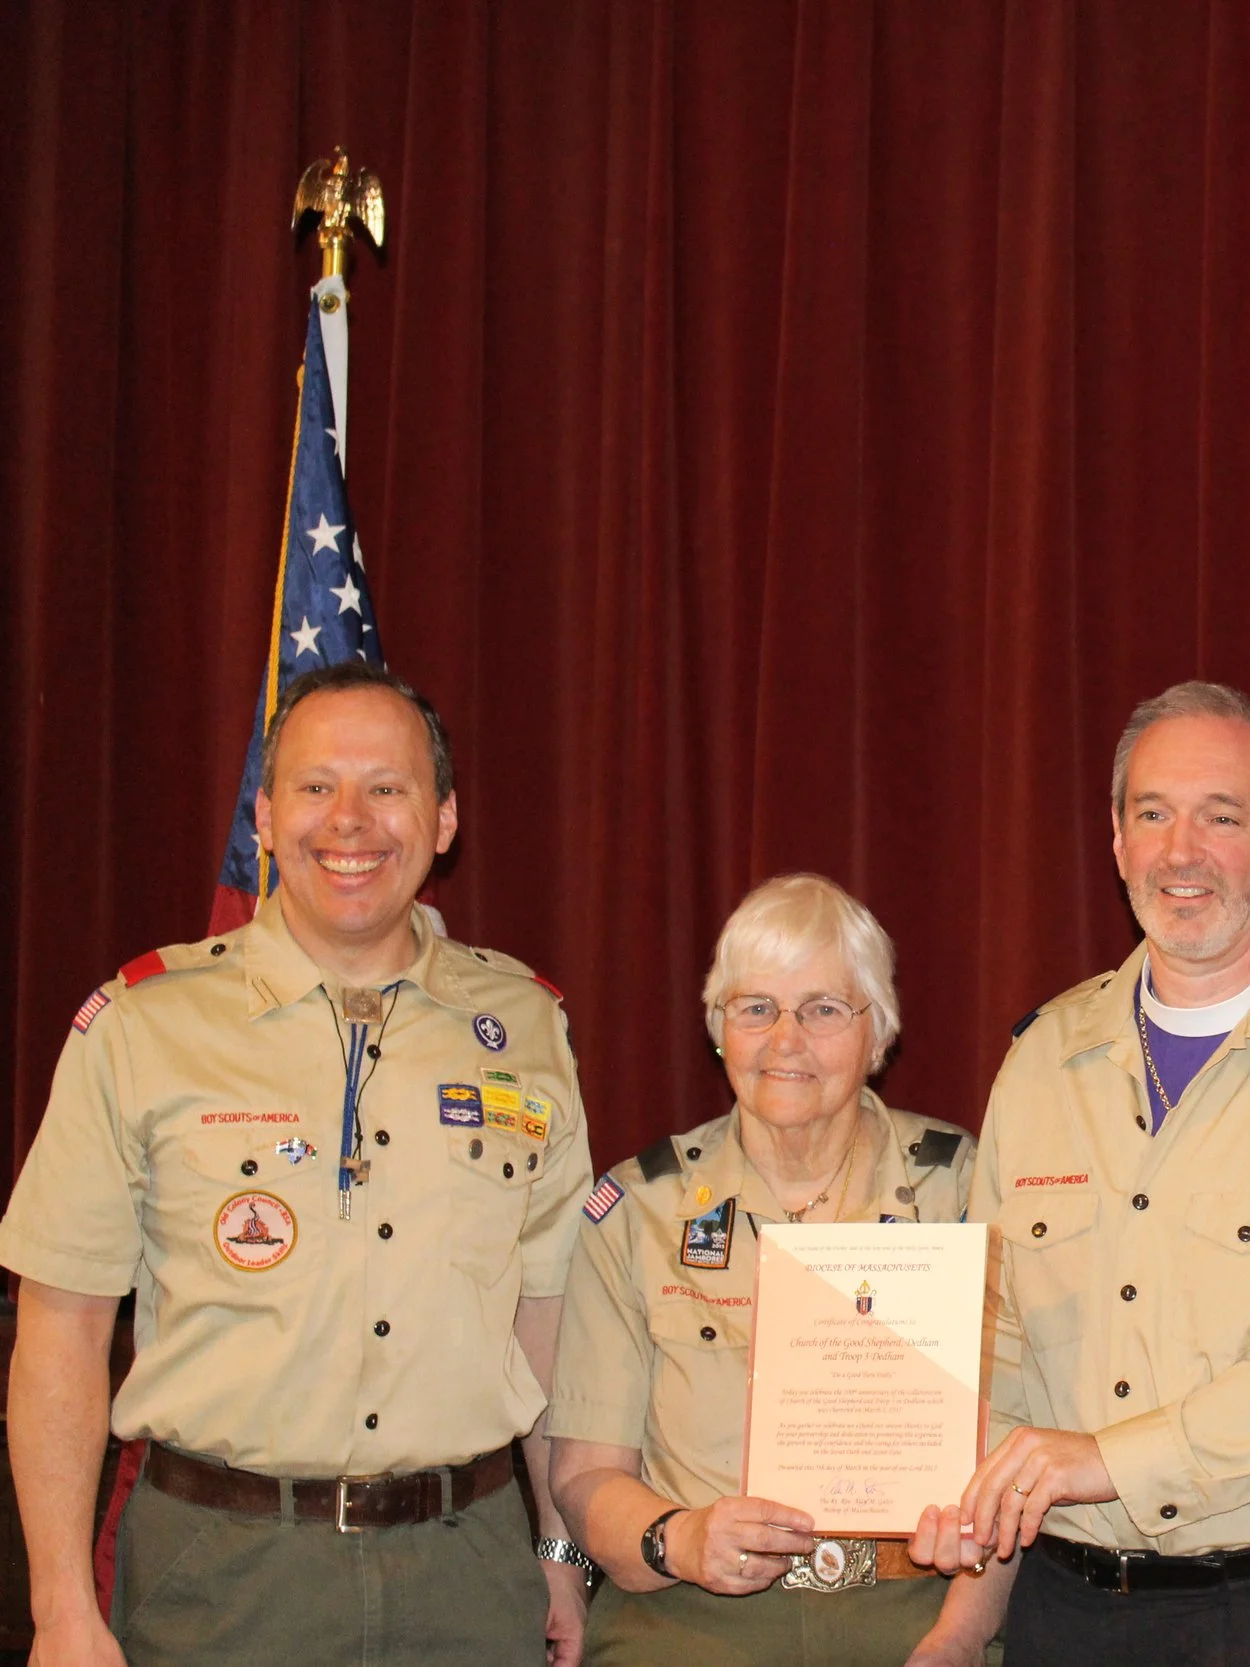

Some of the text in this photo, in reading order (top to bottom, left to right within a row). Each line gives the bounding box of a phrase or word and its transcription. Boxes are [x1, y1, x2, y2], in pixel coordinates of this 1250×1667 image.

[201, 1113, 217, 1124] BOY
[218, 1112, 252, 1123] SCOUTS
[260, 1112, 300, 1123] AMERICA
[1015, 1178, 1027, 1188] BOY
[1027, 1176, 1055, 1186] SCOUTS
[1061, 1173, 1088, 1185] AMERICA
[227, 1197, 250, 1212] Colony
[251, 1195, 280, 1210] Council
[687, 1248, 724, 1257] NATIONAL
[687, 1254, 724, 1262] JAMBOREE
[246, 1257, 272, 1266] Leader
[804, 1263, 932, 1273] DIOCESE OF MASSACHUSETTS
[662, 1285, 679, 1295] BOY
[679, 1286, 707, 1302] SCOUTS
[716, 1297, 752, 1306] AMERICA
[790, 1337, 818, 1348] Church
[819, 1337, 829, 1350] of
[829, 1337, 842, 1347] the
[843, 1337, 866, 1350] Good
[907, 1336, 939, 1348] Dedham
[822, 1352, 838, 1361] and
[838, 1351, 863, 1364] Troop
[871, 1352, 905, 1361] Dedham
